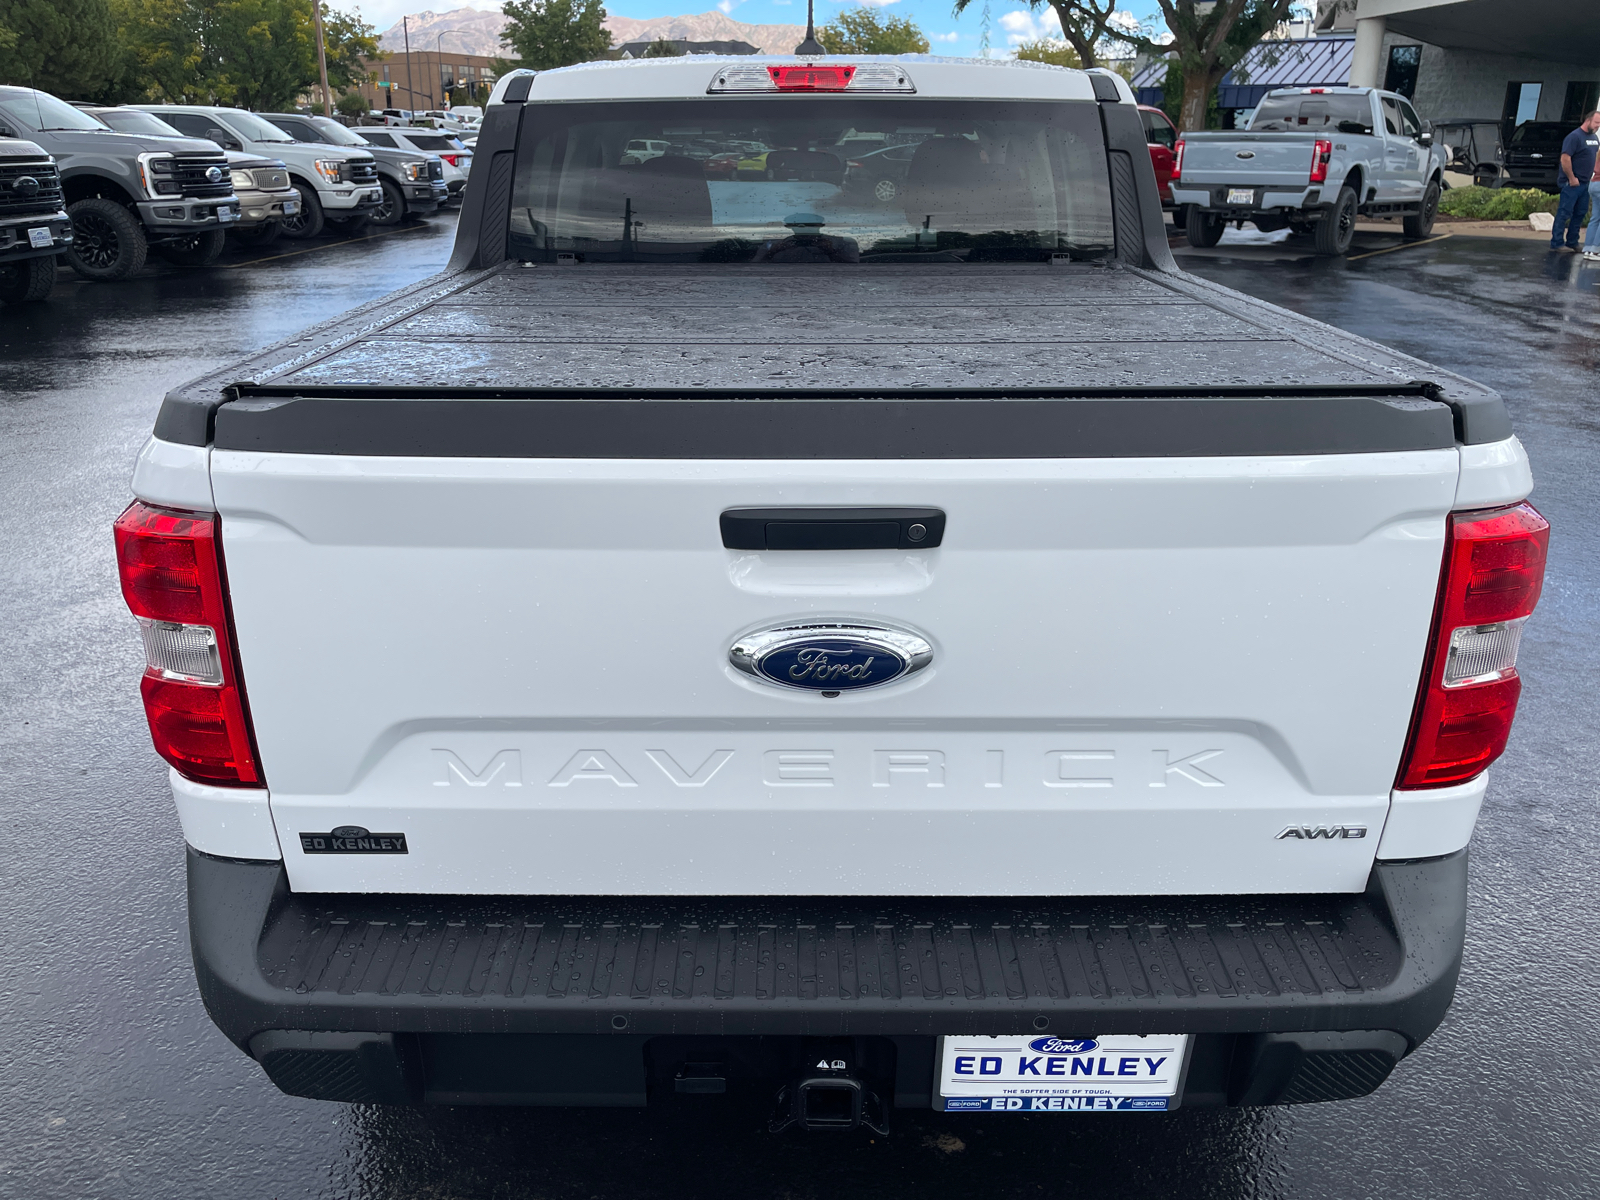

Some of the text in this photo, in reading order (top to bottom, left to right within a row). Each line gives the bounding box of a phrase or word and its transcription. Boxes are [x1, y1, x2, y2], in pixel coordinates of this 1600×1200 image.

[788, 647, 875, 681] Ford
[431, 748, 1226, 788] MAVERICK
[340, 829, 360, 837] Ford
[1274, 825, 1367, 839] AWD
[301, 838, 404, 850] ED KENLEY
[1042, 1038, 1085, 1052] Ford
[954, 1056, 1168, 1076] ED KENLEY
[990, 1097, 1023, 1110] ED
[1030, 1097, 1125, 1110] KENLEY
